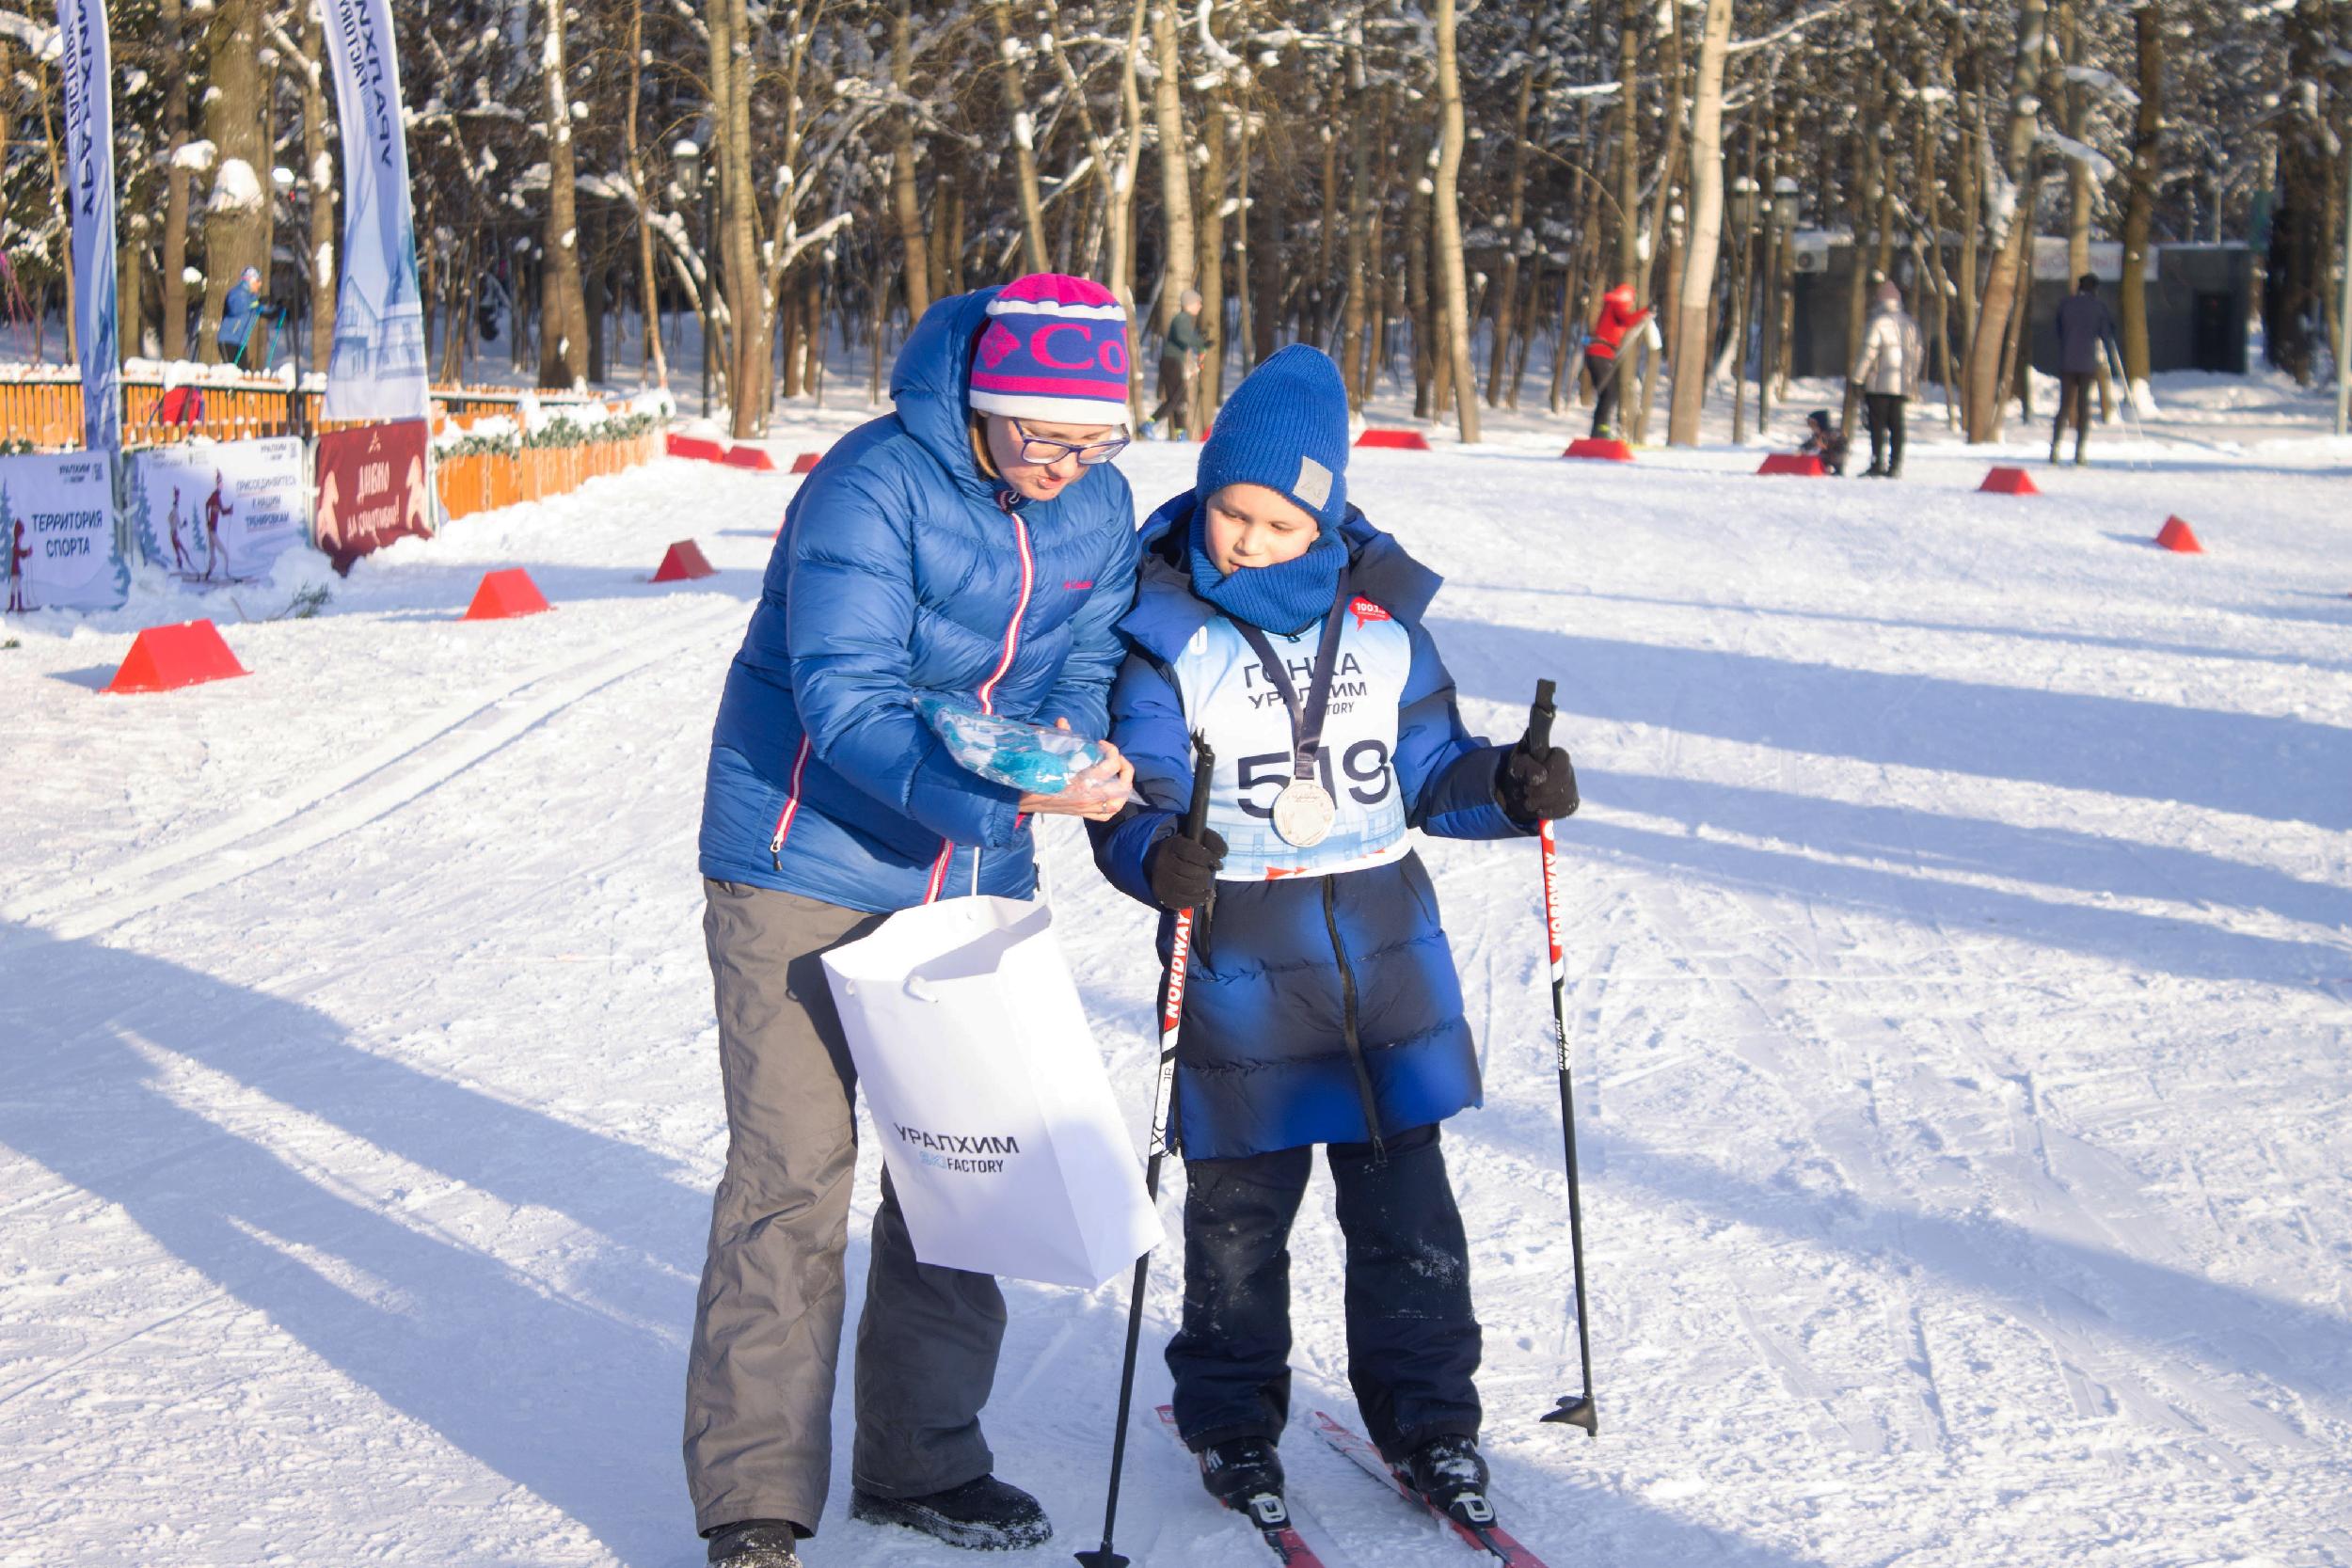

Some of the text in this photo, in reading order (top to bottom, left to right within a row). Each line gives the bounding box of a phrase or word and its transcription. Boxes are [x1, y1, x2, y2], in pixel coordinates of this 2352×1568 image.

[31, 509, 103, 532] ТЕРРИТОРИЯ
[46, 537, 90, 558] СПОРТА
[1244, 652, 1362, 689] ГНА
[1248, 681, 1368, 709] УРЛИМ
[1237, 738, 1391, 819] 519
[1166, 910, 1191, 1019] NORDWAY
